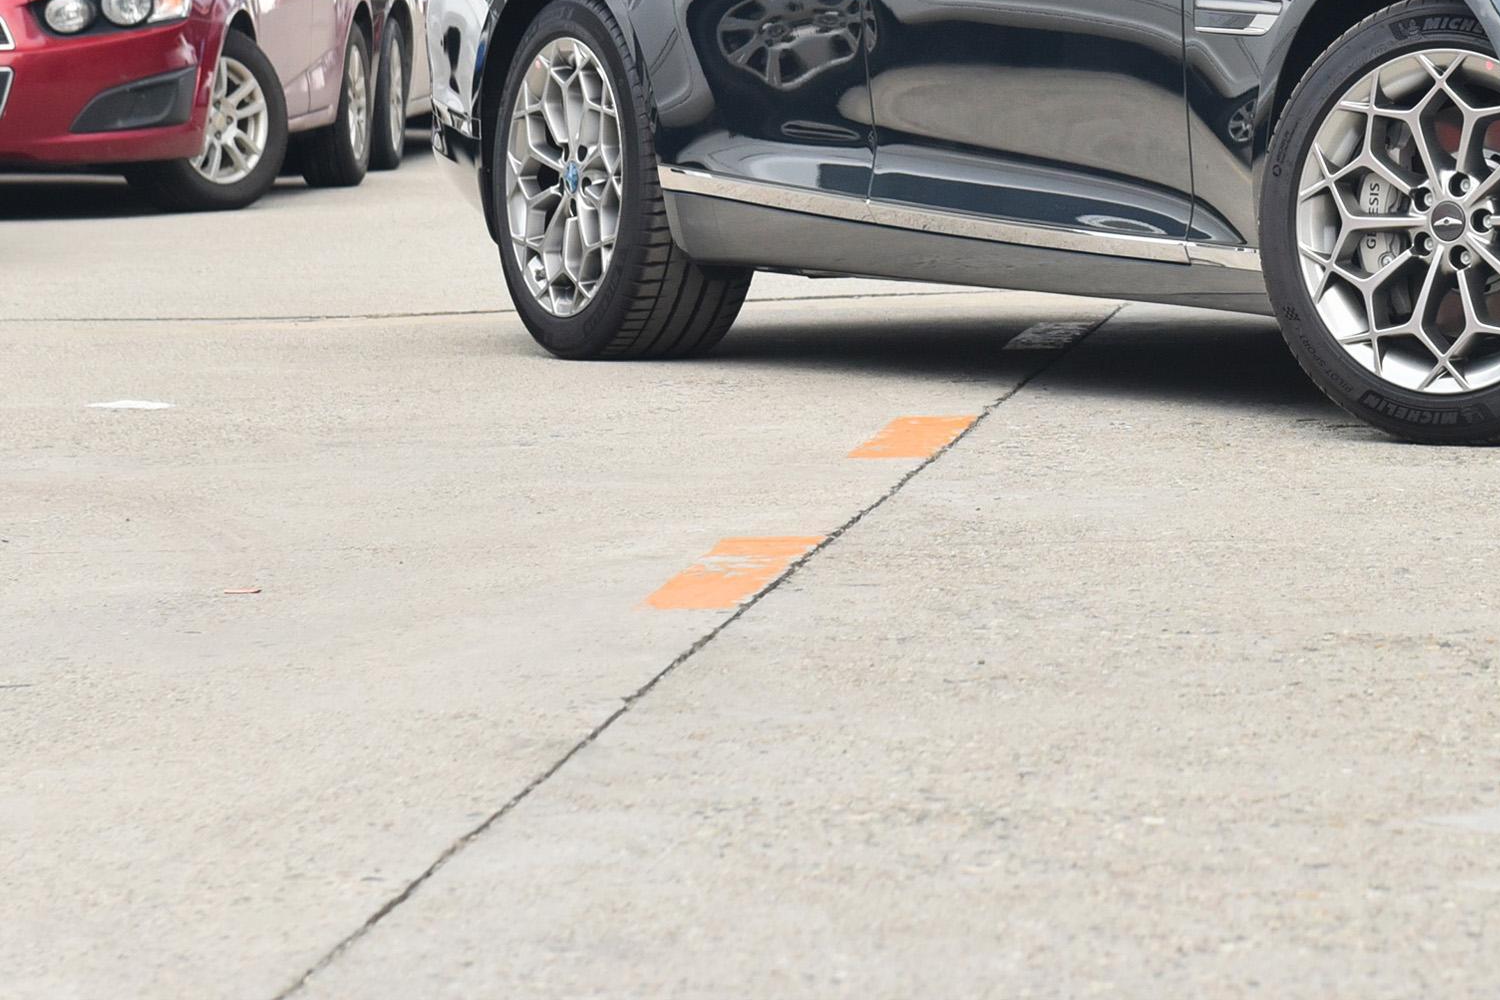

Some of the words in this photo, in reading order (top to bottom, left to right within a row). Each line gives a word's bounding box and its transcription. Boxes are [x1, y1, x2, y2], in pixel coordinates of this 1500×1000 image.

[1422, 16, 1486, 34] MICHE
[1366, 182, 1381, 250] GEESIS
[1362, 391, 1458, 425] MICHELIN
